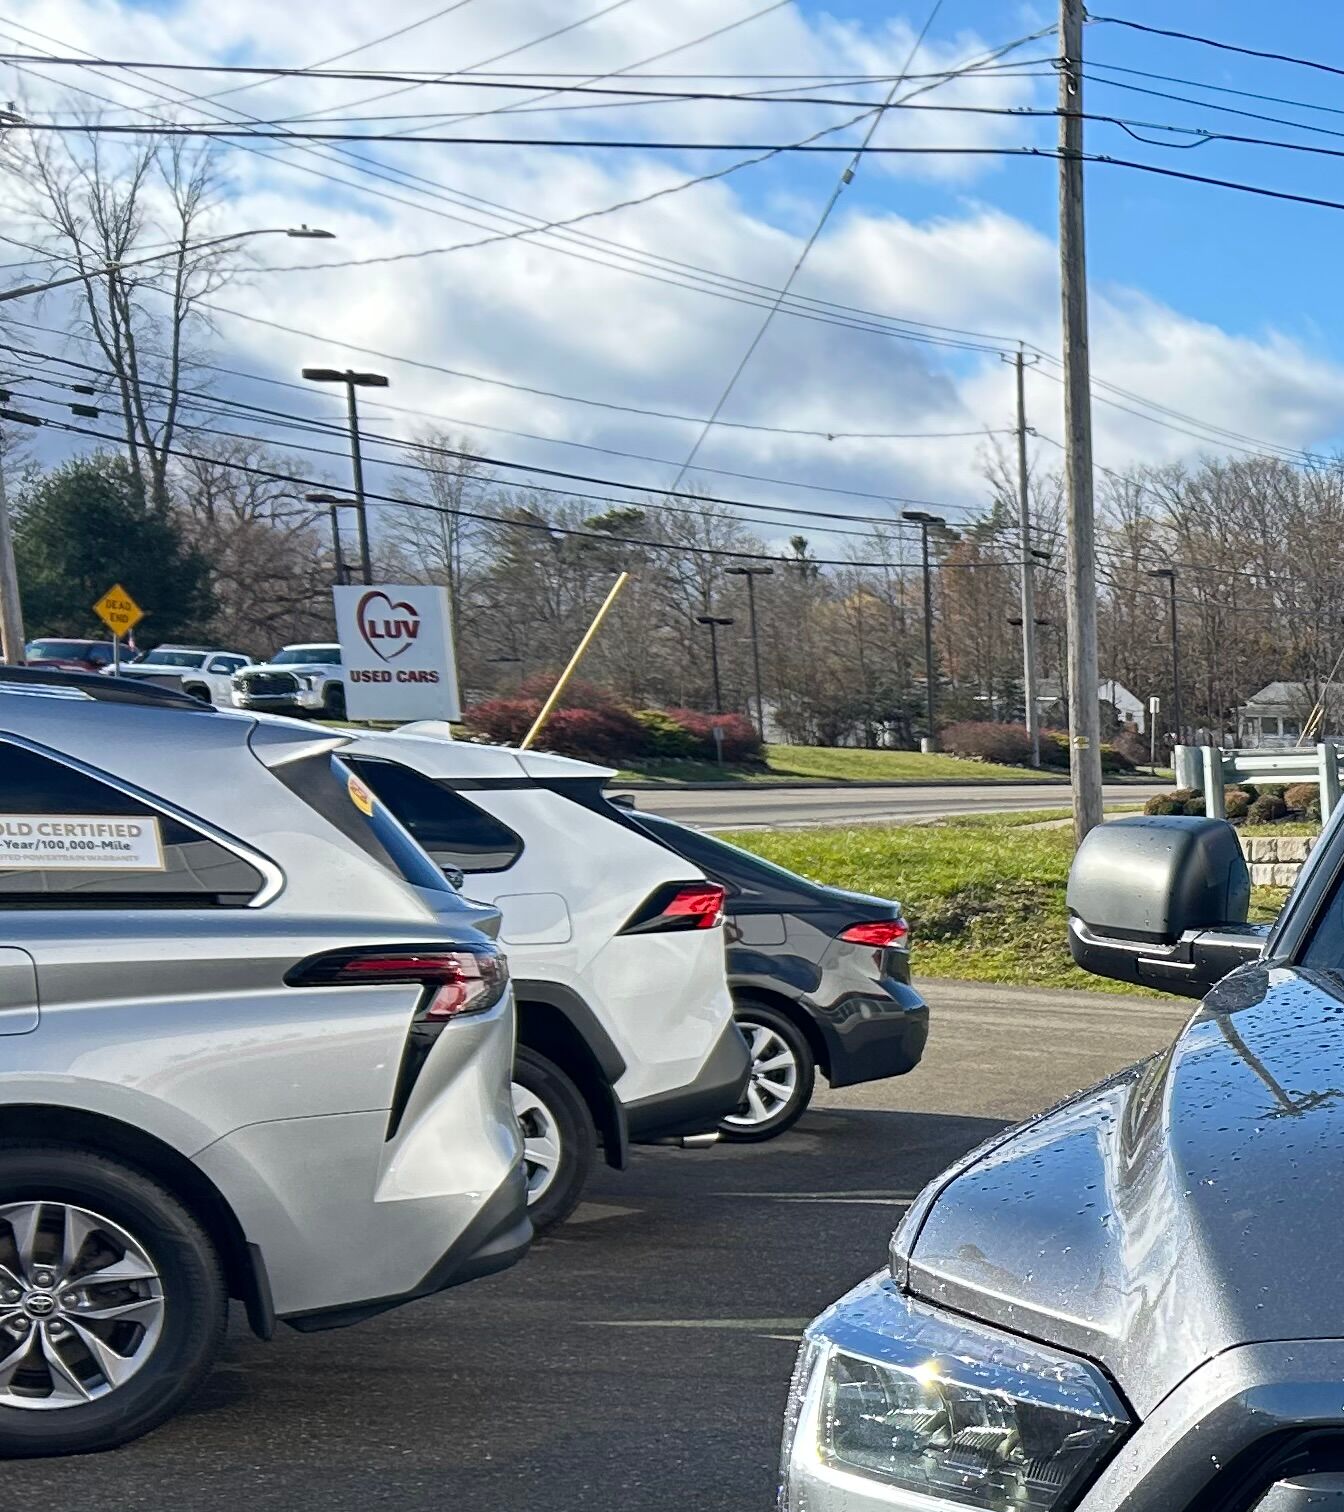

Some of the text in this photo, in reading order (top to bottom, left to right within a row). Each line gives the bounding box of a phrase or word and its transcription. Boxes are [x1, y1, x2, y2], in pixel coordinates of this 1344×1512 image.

[105, 599, 132, 611] DEAD
[110, 612, 129, 623] END
[367, 619, 420, 639] LUV
[349, 670, 440, 683] USED CARS
[37, 823, 142, 838] CERTIFIED
